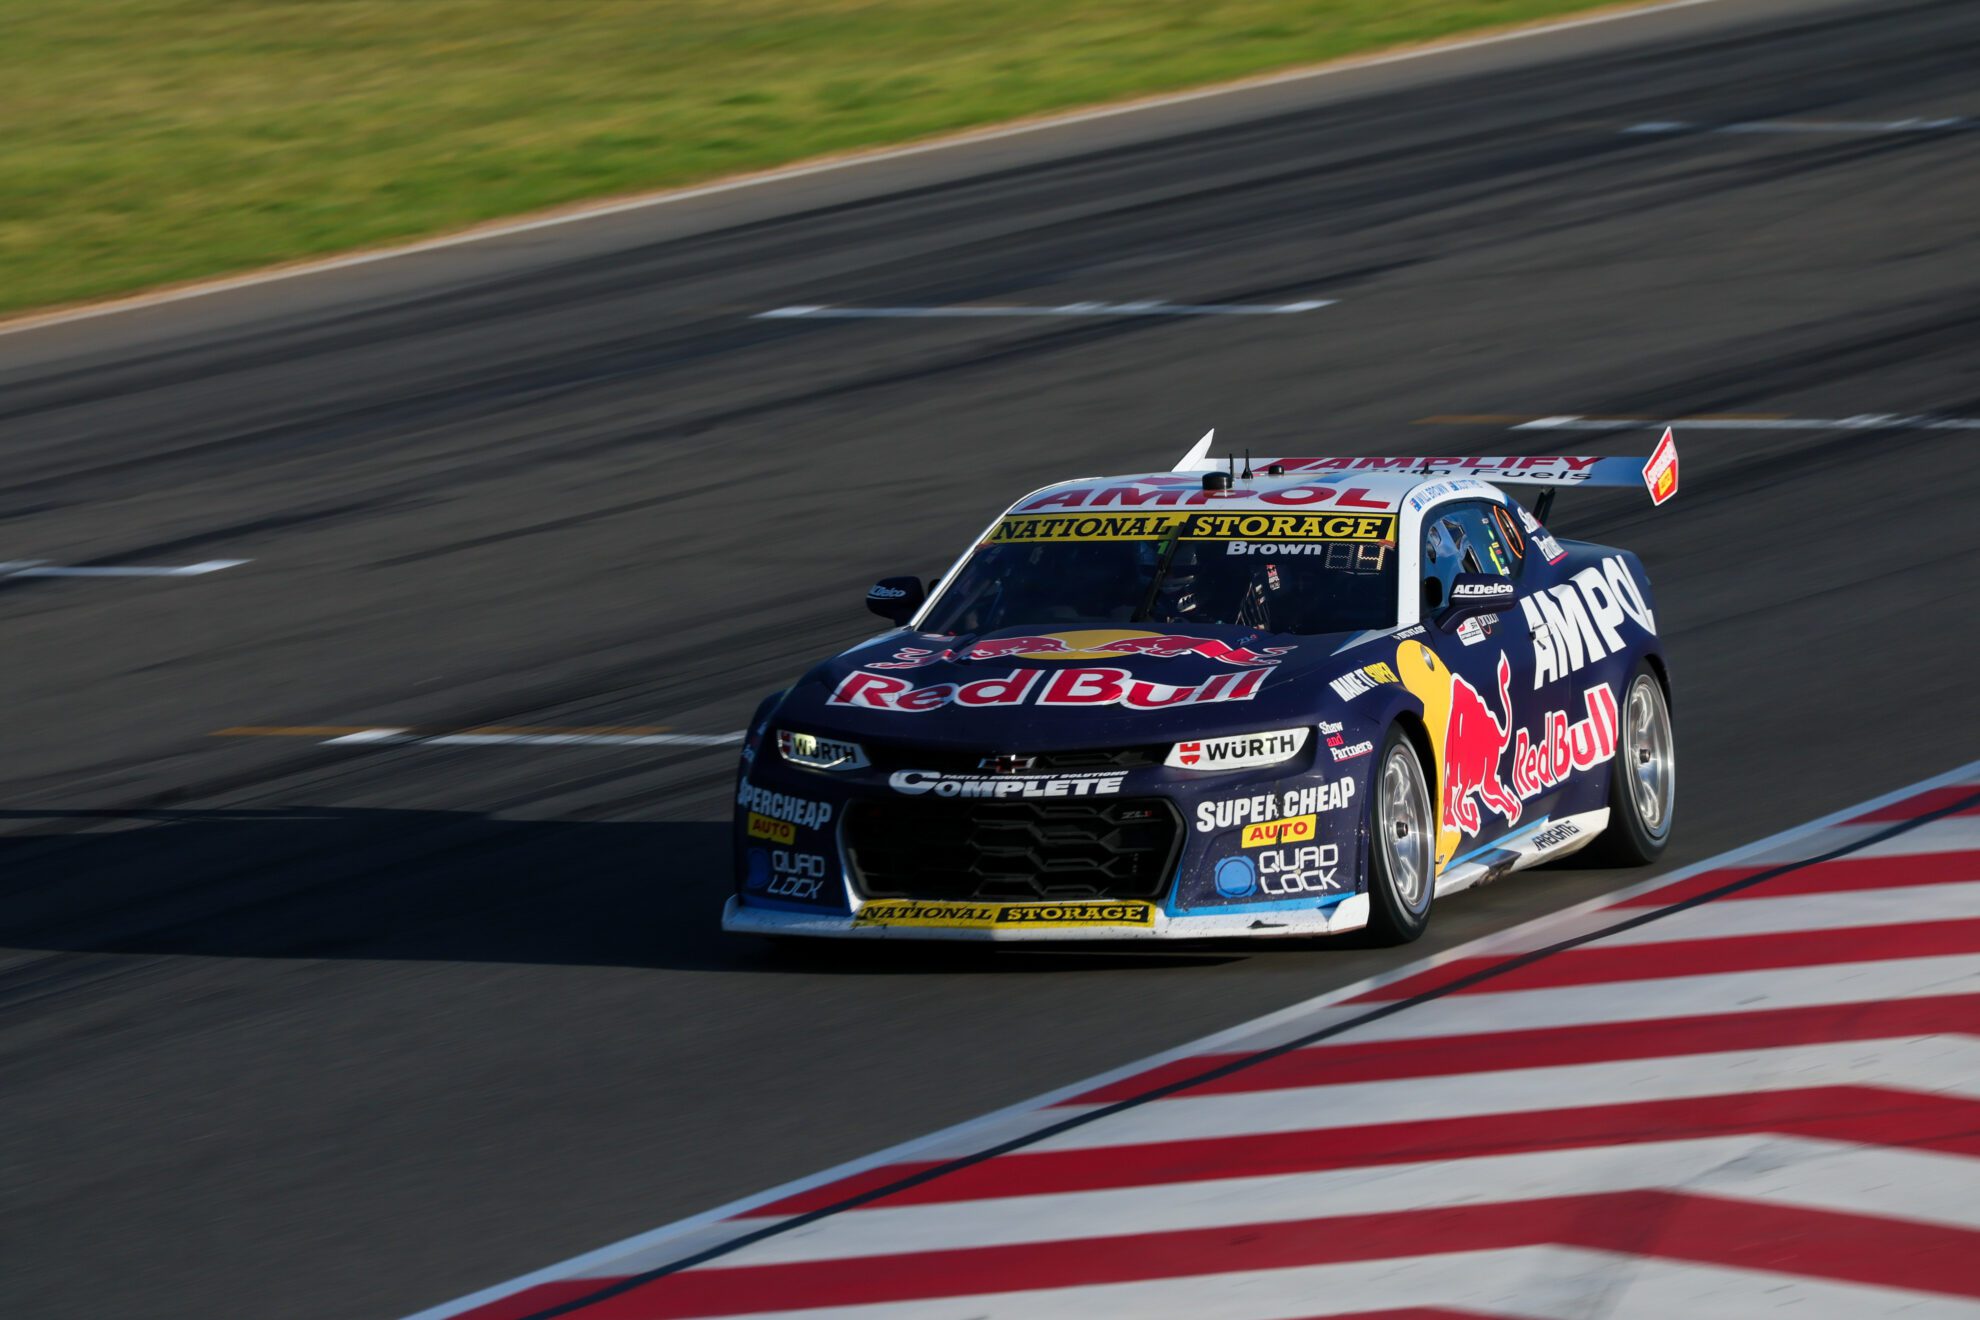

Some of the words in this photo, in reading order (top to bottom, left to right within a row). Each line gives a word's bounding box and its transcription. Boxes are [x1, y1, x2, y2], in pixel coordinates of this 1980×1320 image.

[1305, 456, 1606, 471] AMPLIFY
[1471, 468, 1593, 481] Fuels
[1020, 485, 1393, 511] AMPOL
[992, 516, 1176, 540] NATIONAL
[1192, 515, 1383, 538] STORAGE
[1226, 541, 1323, 556] Brown
[1453, 582, 1514, 595] ACDelco
[1519, 554, 1657, 691] AMPOL
[825, 669, 1046, 712] Red
[1036, 666, 1279, 711] Bull
[1328, 671, 1371, 702] MAKE
[1318, 720, 1344, 735] Shaw
[1206, 733, 1295, 761] WÜRTH
[1326, 732, 1345, 747] and
[1329, 740, 1374, 761] Partners
[888, 768, 1124, 798] COMPLETE
[1060, 769, 1129, 780] SOLUTIONS
[751, 817, 791, 839] AUTO
[1249, 821, 1308, 842] AUTO
[771, 850, 826, 878] QUAD
[1259, 843, 1339, 874] QUAD
[767, 874, 825, 900] LOCK
[1259, 866, 1342, 895] LOCK
[859, 904, 994, 921] NATIONAL
[1007, 905, 1145, 922] STORAGE
